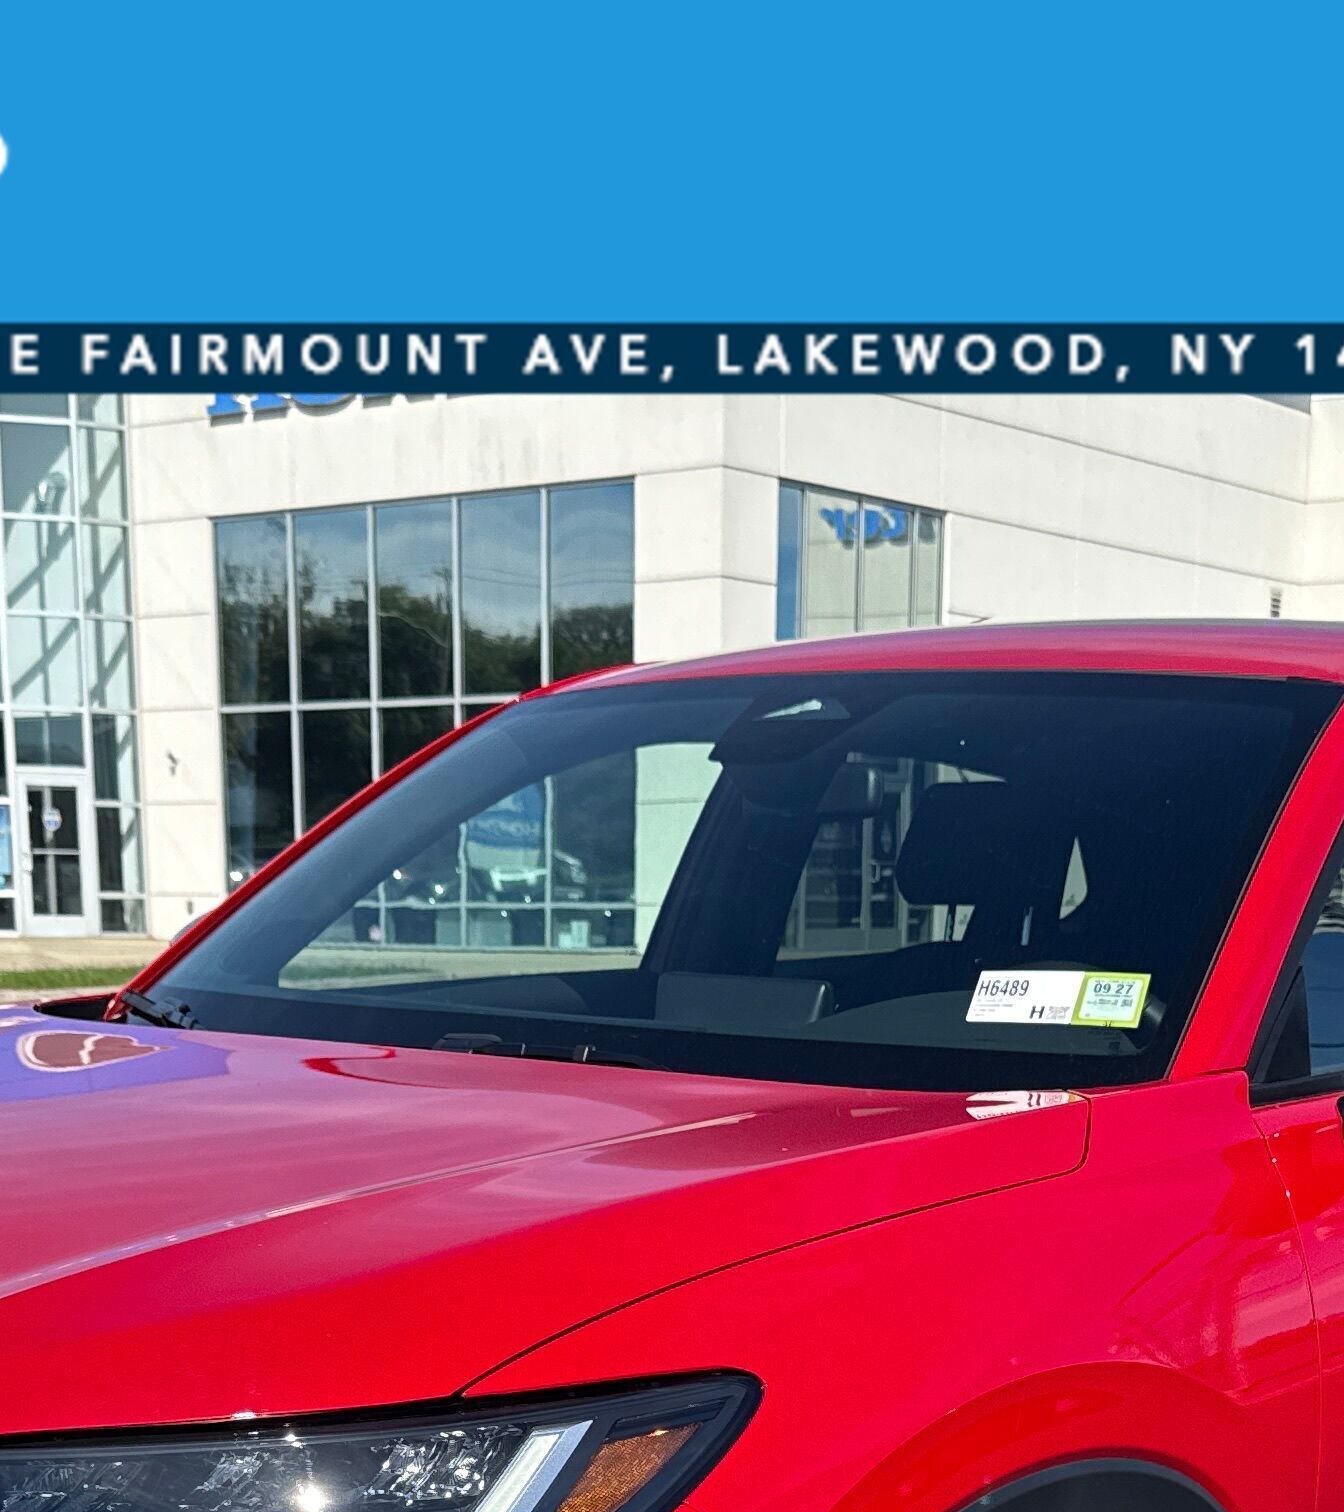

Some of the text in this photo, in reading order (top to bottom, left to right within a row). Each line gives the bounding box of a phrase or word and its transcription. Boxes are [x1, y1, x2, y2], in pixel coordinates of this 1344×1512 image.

[978, 980, 1030, 997] H6489
[1094, 982, 1134, 995] 09 27
